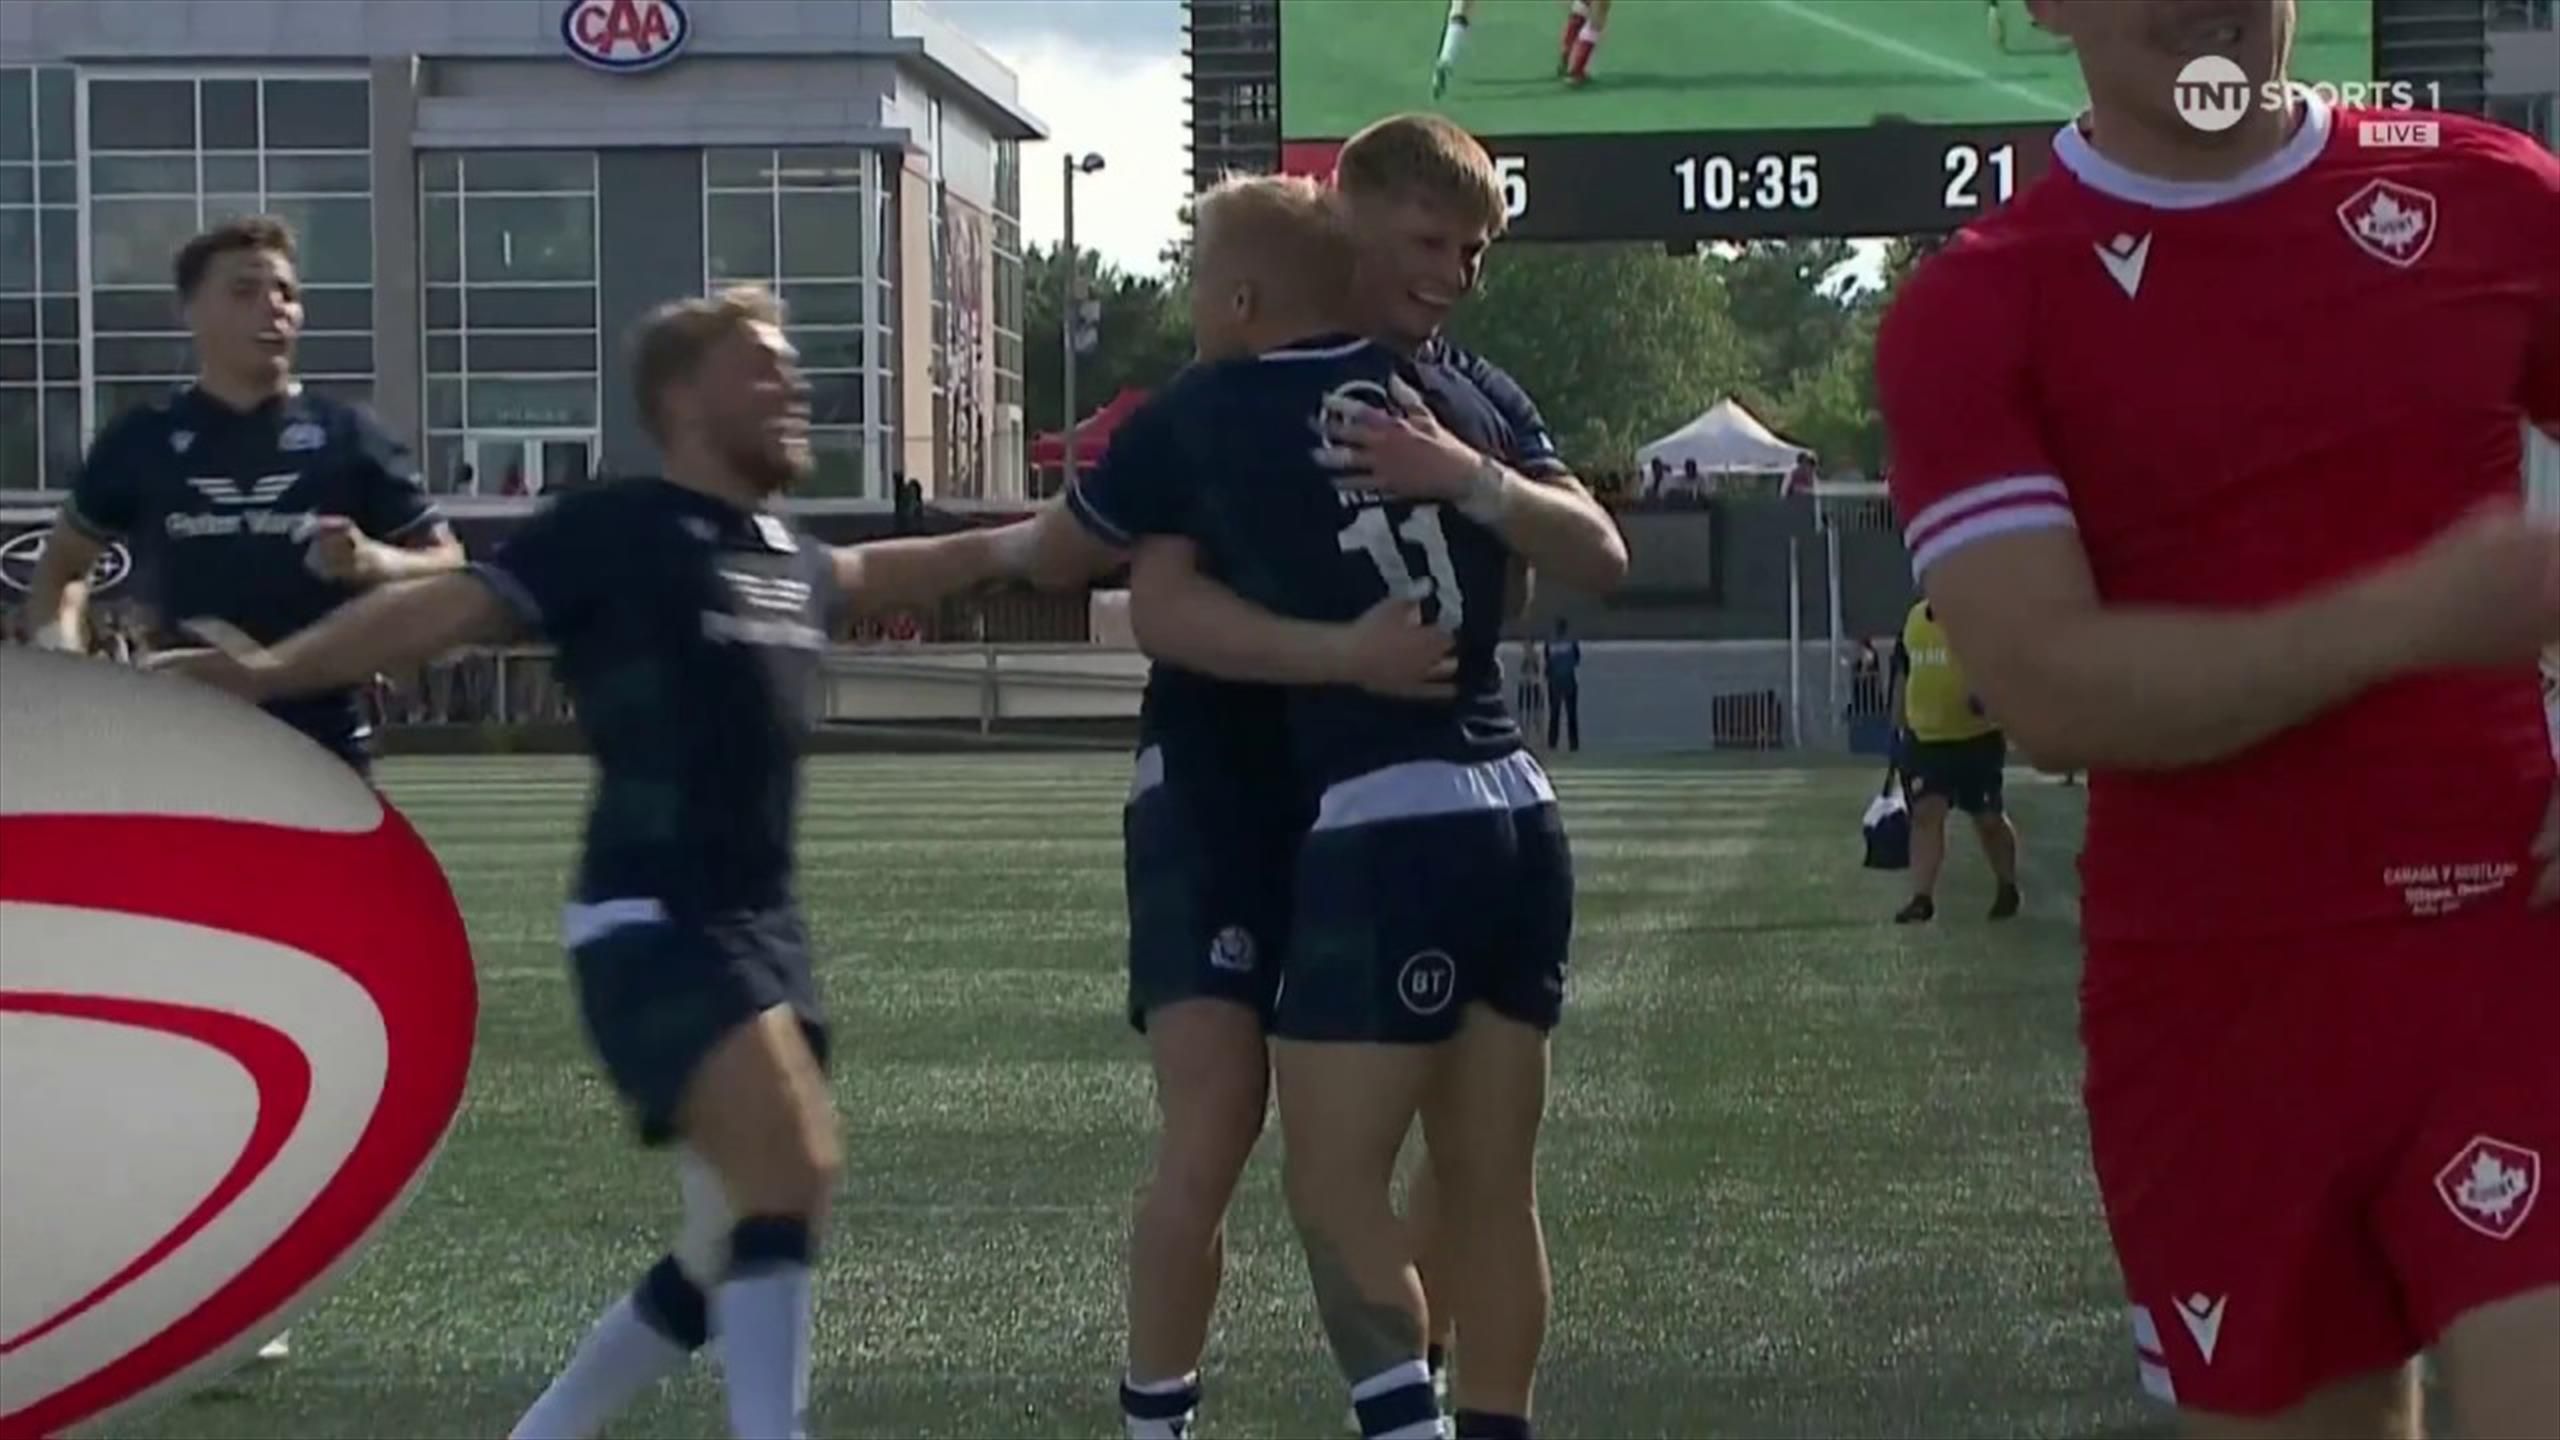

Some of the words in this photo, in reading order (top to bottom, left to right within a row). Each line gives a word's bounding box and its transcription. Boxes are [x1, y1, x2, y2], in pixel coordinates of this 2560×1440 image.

[576, 0, 671, 54] CAA
[1674, 155, 1820, 210] 10:35
[1943, 146, 2015, 207] 21
[1338, 503, 1464, 632] 11
[1412, 969, 1447, 994] BT
